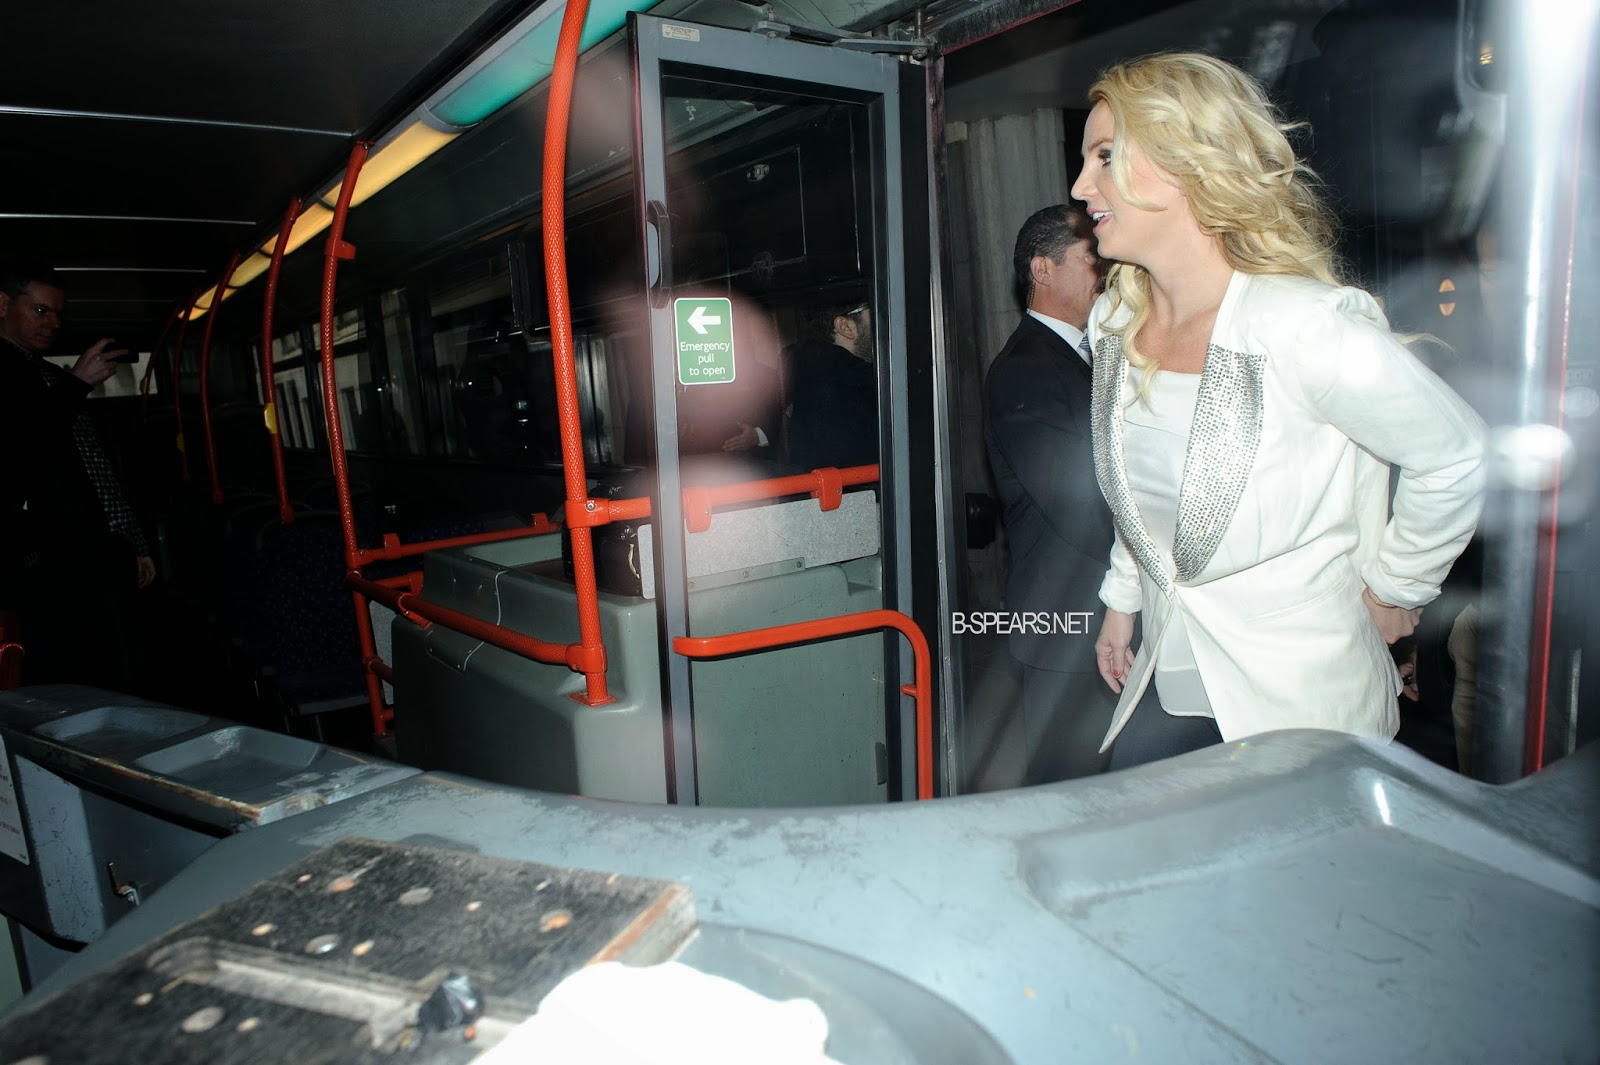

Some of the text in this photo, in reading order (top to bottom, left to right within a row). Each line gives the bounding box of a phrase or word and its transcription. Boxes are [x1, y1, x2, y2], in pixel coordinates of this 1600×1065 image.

[680, 342, 730, 352] Emergency
[698, 353, 715, 365] pull
[689, 367, 726, 377] to open
